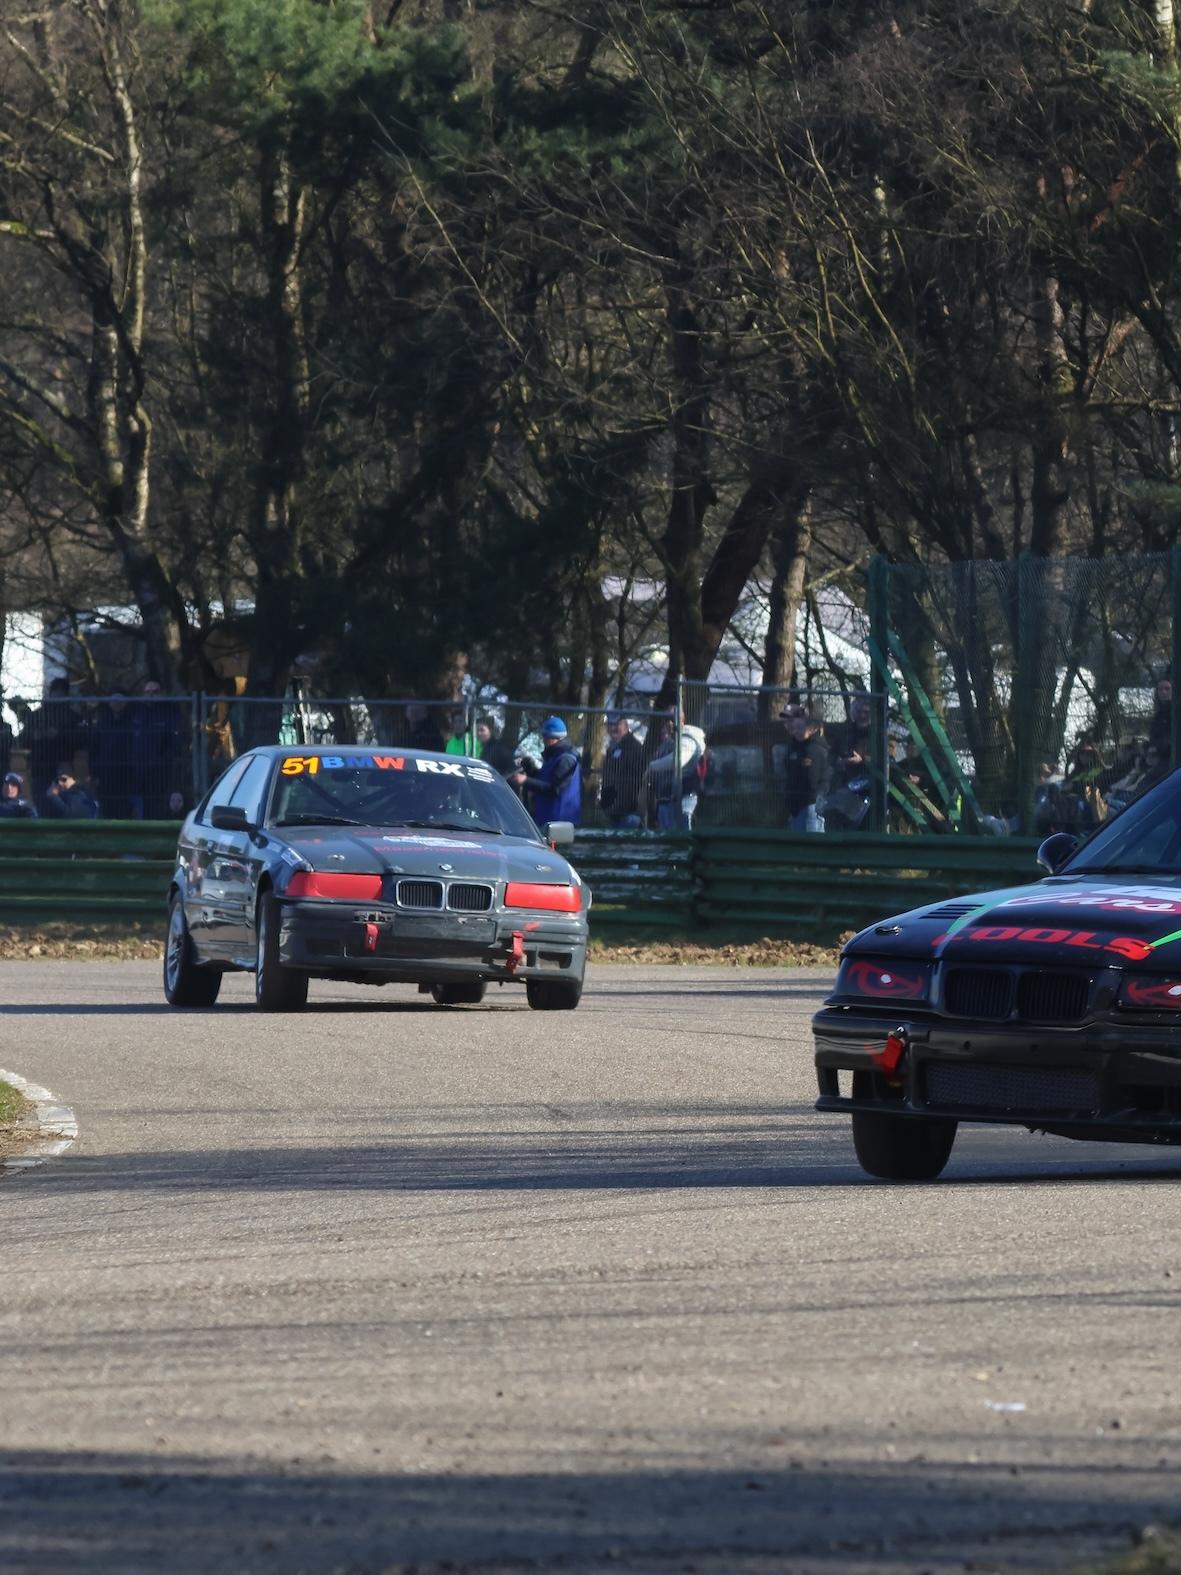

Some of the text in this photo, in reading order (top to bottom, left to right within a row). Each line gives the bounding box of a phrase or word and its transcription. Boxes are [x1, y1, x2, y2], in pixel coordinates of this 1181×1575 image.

[280, 756, 321, 776] 51
[320, 756, 406, 771] BMW
[415, 759, 465, 778] RX
[931, 926, 1156, 961] COOLS
